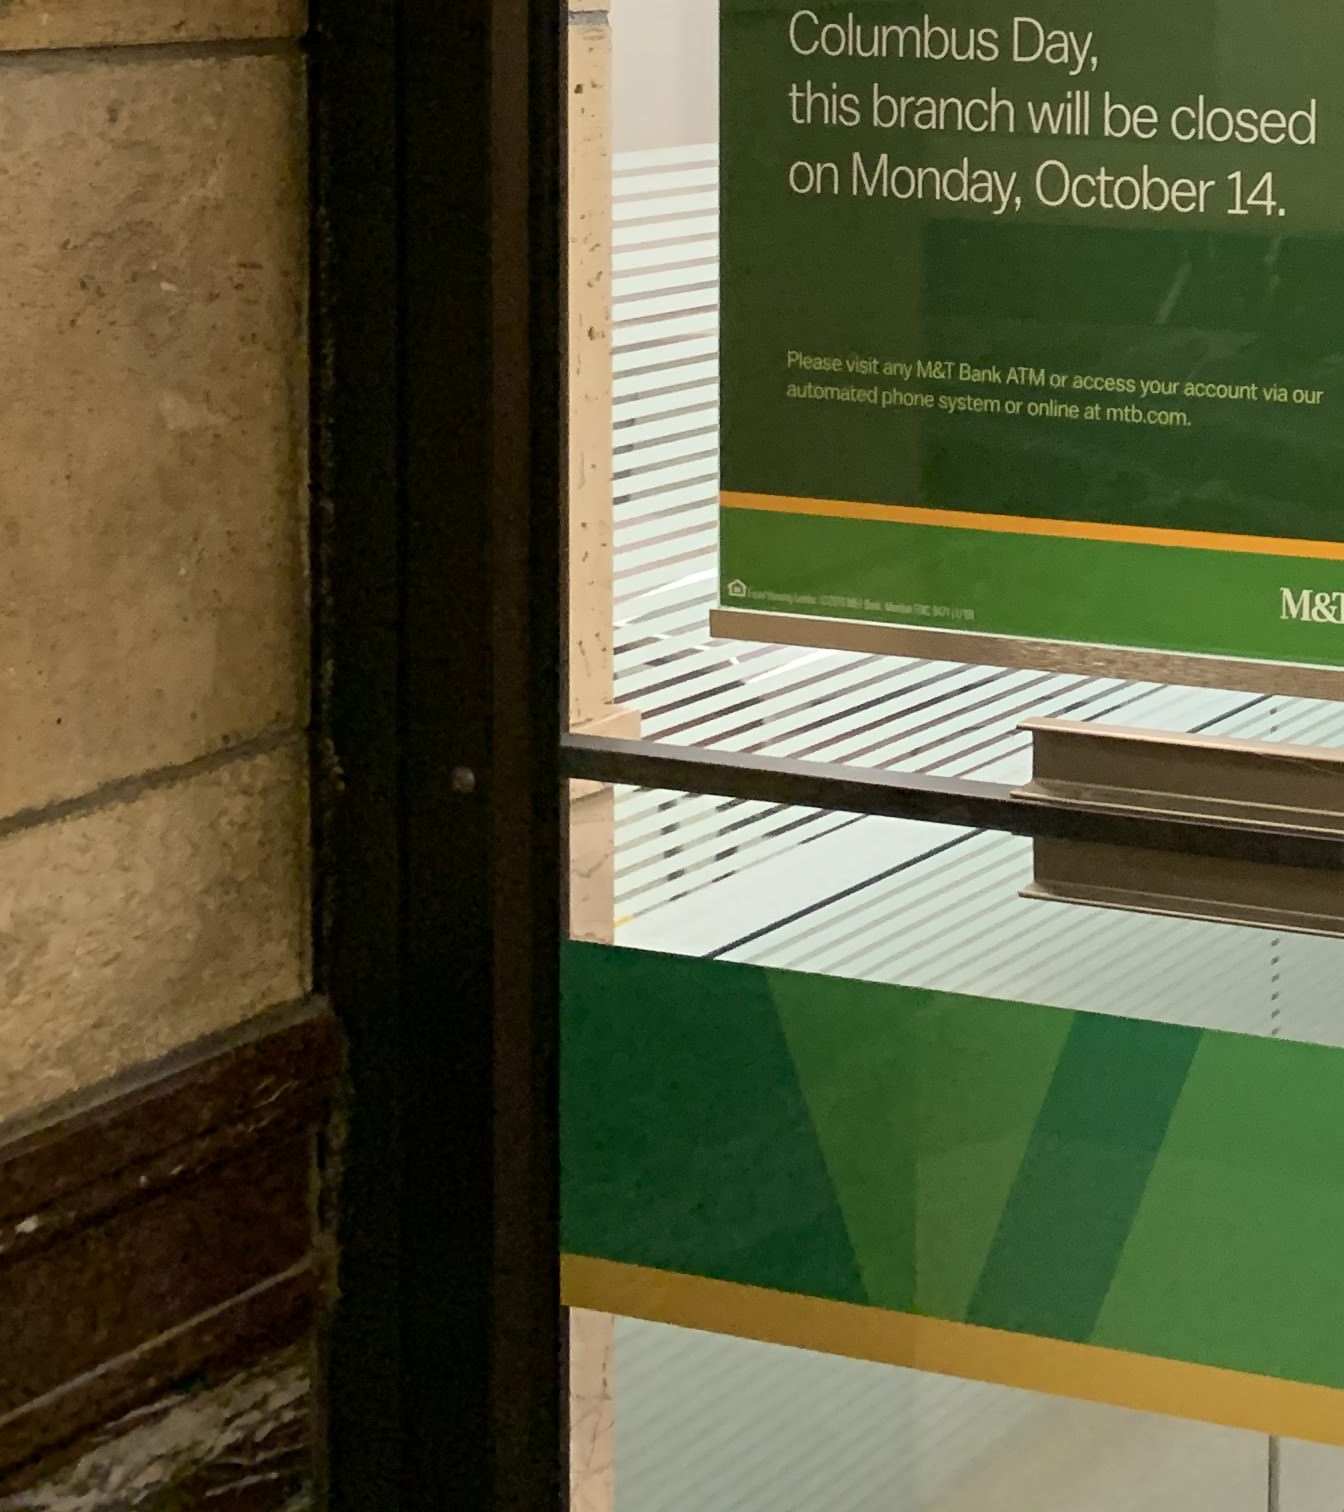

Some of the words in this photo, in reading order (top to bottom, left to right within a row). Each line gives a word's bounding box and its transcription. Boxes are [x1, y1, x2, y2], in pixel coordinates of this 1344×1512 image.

[789, 10, 1000, 62] Columbus
[1012, 17, 1099, 75] Day,
[788, 81, 862, 126] this
[872, 84, 1015, 133] branch
[1027, 90, 1090, 136] will
[1103, 92, 1158, 139] be
[1169, 95, 1317, 145] closed
[789, 158, 839, 195] on
[850, 152, 1022, 215] Monday,
[1034, 160, 1215, 213] October
[1225, 169, 1287, 216] 14.
[786, 382, 878, 404] automated
[882, 389, 934, 408] phone
[939, 396, 1000, 414] system
[1004, 400, 1022, 414] or
[1027, 400, 1079, 419] online
[1084, 403, 1101, 420] at
[1107, 404, 1191, 427] mtb.com.
[787, 350, 842, 372] Please
[846, 355, 879, 374] visit
[882, 364, 912, 380] any
[917, 360, 955, 379] M&T
[959, 363, 1001, 384] Bank
[1006, 367, 1045, 386] ATM
[1050, 374, 1068, 389] or
[1073, 375, 1136, 393] access
[1140, 380, 1179, 397] your
[1183, 383, 1258, 400] account
[1263, 384, 1287, 402] via
[1293, 389, 1324, 404] our
